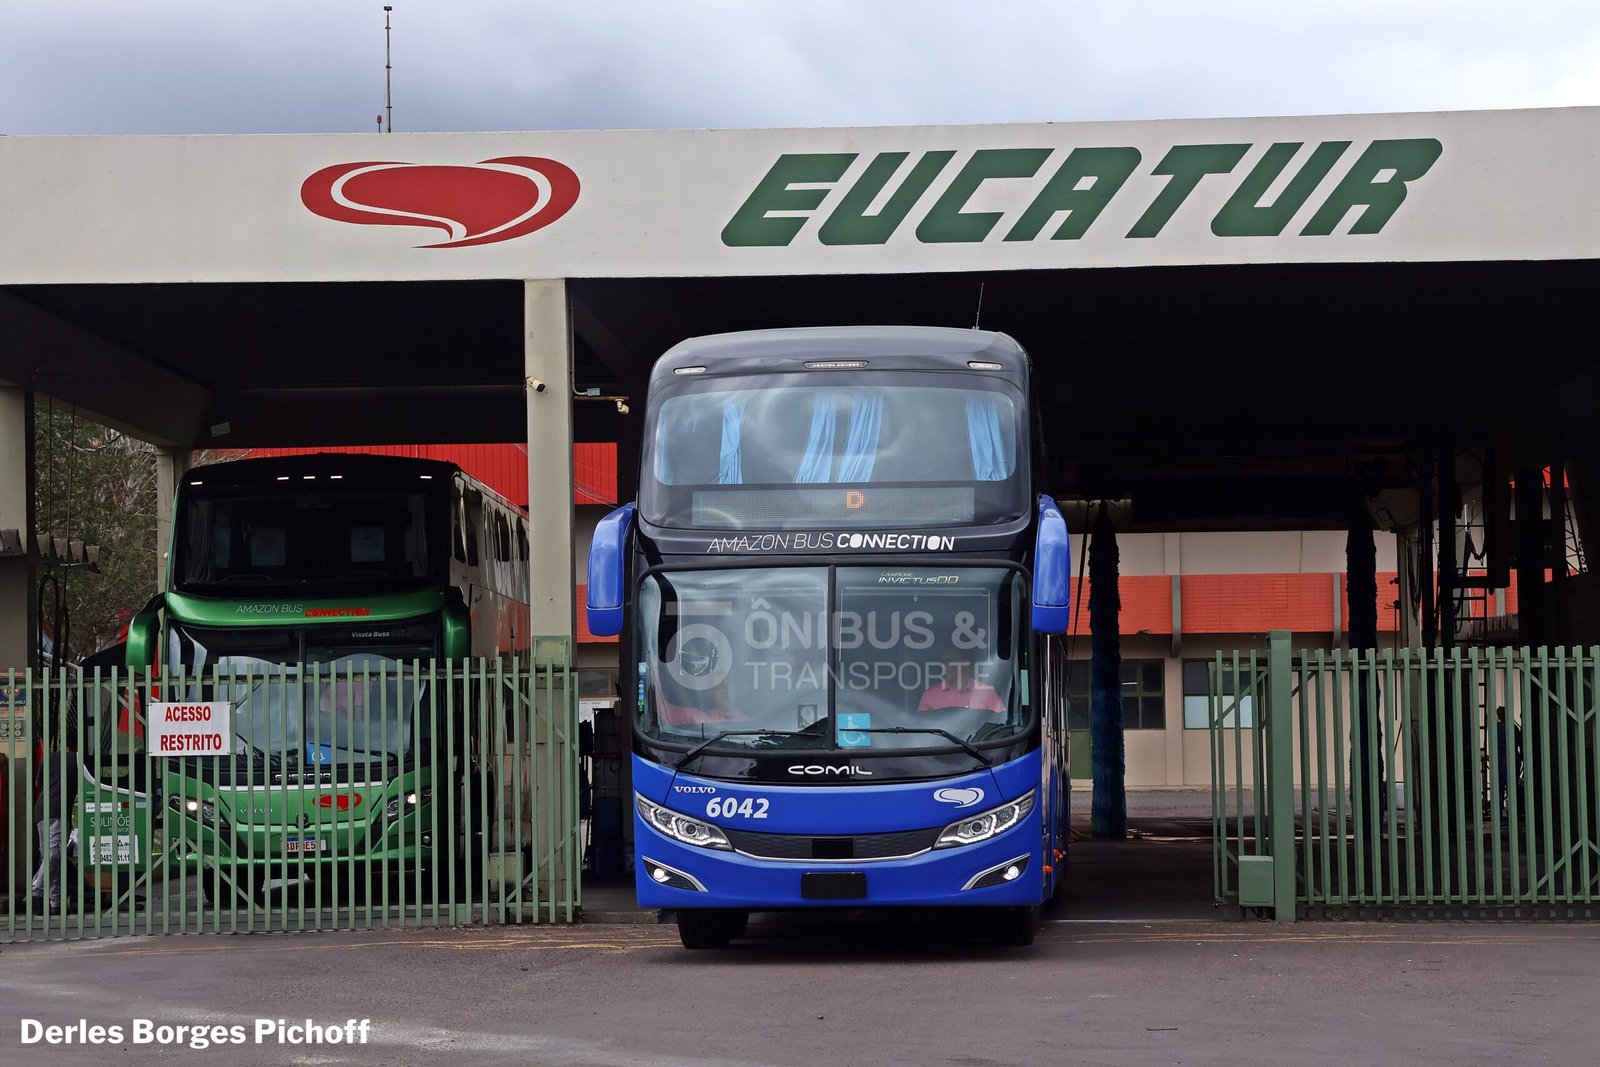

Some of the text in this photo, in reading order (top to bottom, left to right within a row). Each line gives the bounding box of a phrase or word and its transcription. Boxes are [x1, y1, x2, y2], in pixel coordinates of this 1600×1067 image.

[720, 138, 1444, 247] EUCATUR
[846, 491, 864, 509] D
[707, 532, 956, 554] AMAZON BUS CONNECTION
[236, 603, 370, 617] AMAZON BUS CONNECTION
[165, 705, 211, 722] ACESSO
[160, 733, 222, 751] RESTRITO
[788, 765, 872, 775] COMIL
[674, 785, 716, 794] VOLVO
[706, 797, 770, 819] 6042
